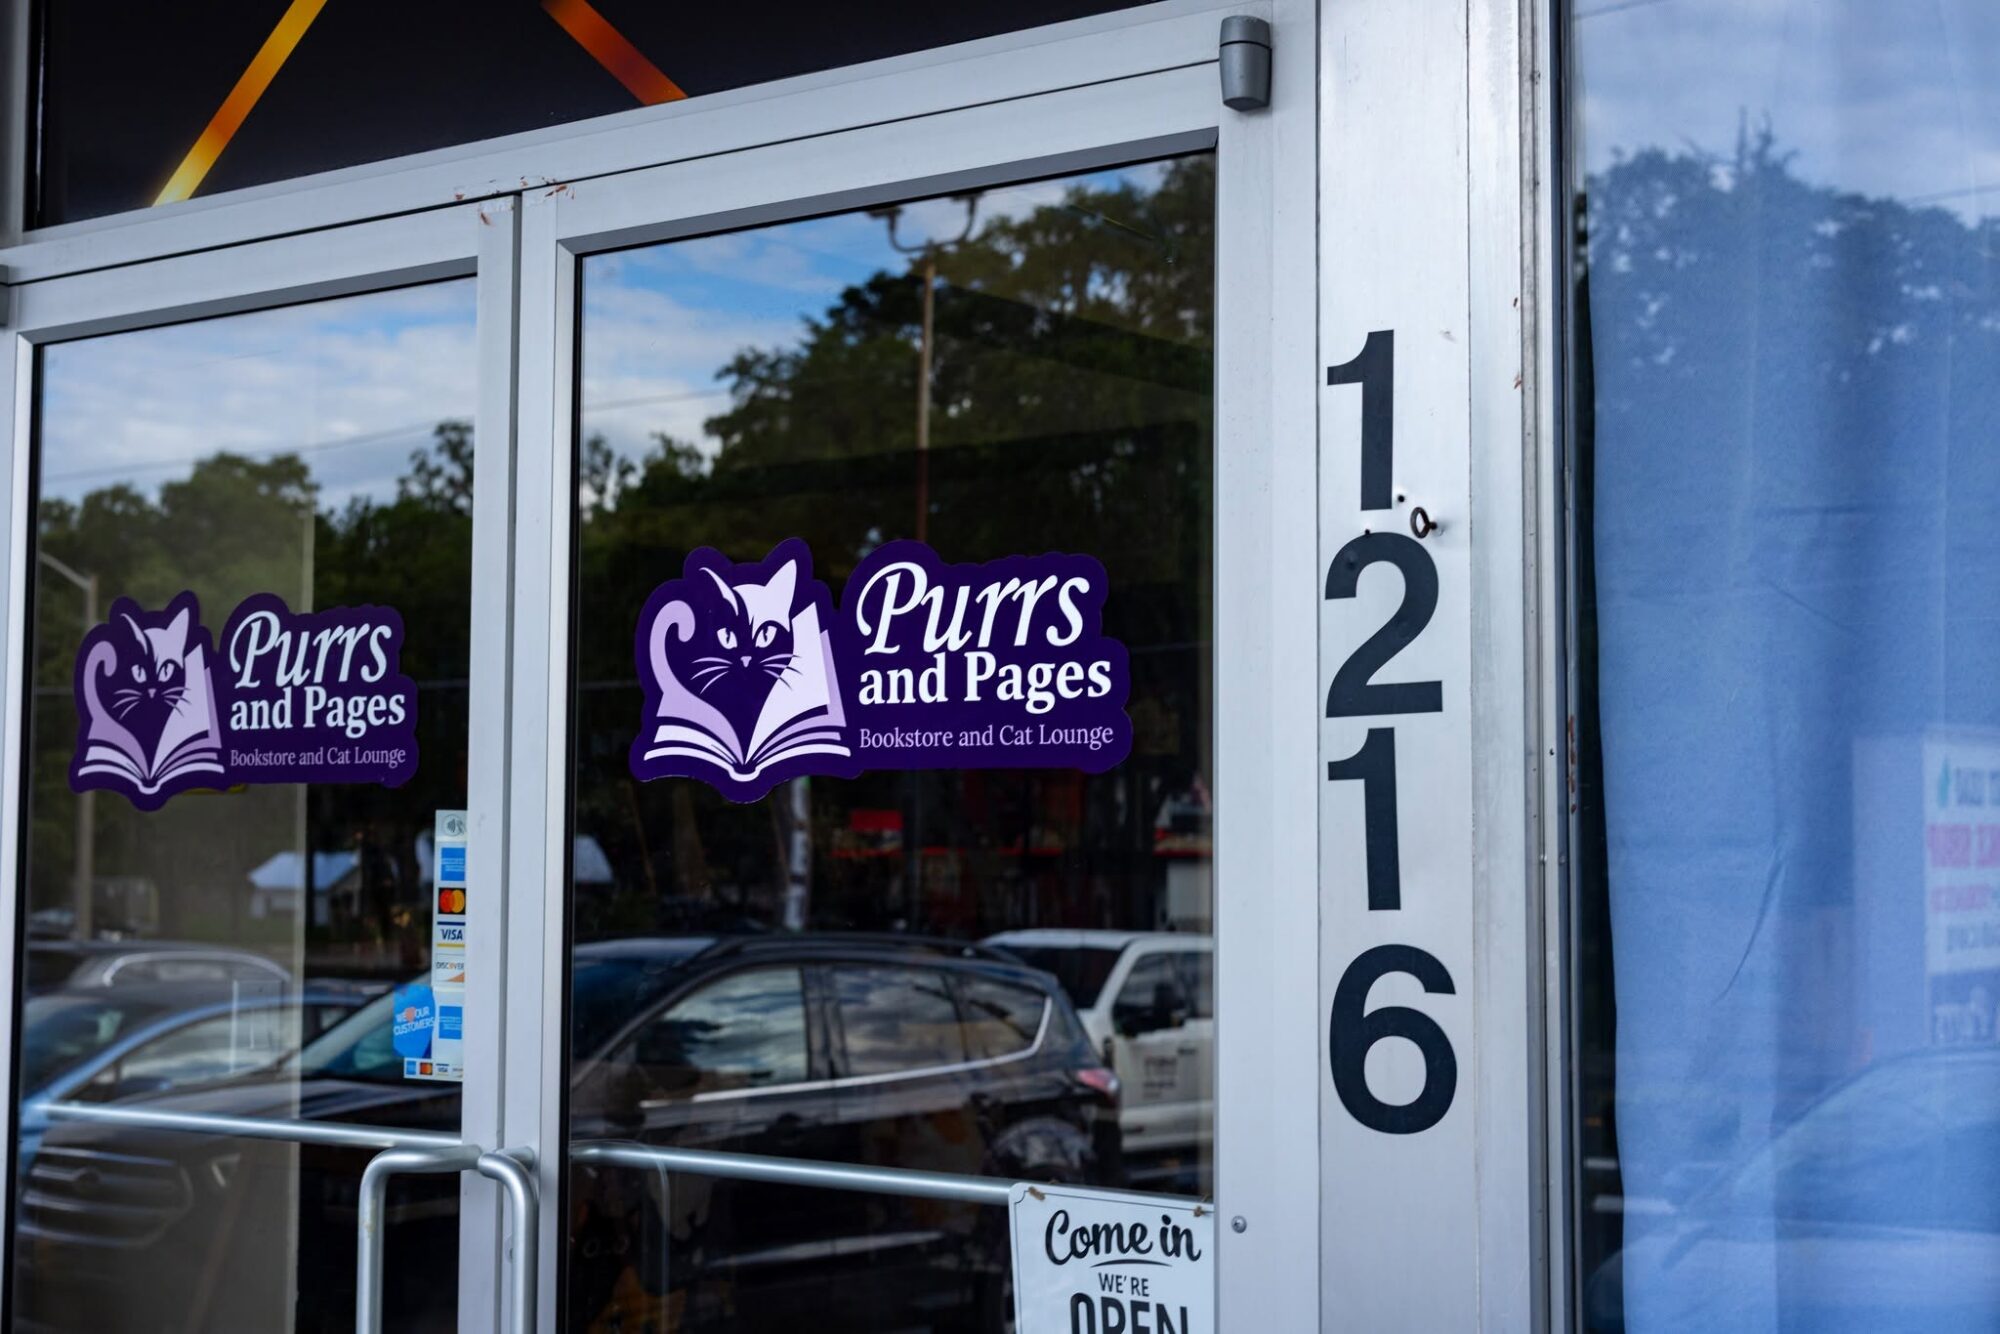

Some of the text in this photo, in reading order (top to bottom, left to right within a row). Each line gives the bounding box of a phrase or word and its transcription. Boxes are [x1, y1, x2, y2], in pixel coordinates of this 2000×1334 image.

[855, 561, 1091, 656] Purrs
[229, 610, 392, 689] Purrs
[858, 651, 1112, 714] and Pages
[230, 685, 406, 738] and Pages
[859, 725, 1114, 751] Bookstore and Cat Lounge
[1325, 329, 1458, 1136] 1216
[230, 747, 406, 769] Bookstore and Cat Lounge
[440, 929, 464, 940] VISA
[393, 1017, 435, 1036] CUSTOMERS
[415, 1006, 430, 1019] OUR
[1045, 1209, 1202, 1266] Come in
[1098, 1272, 1150, 1297] WE'RE
